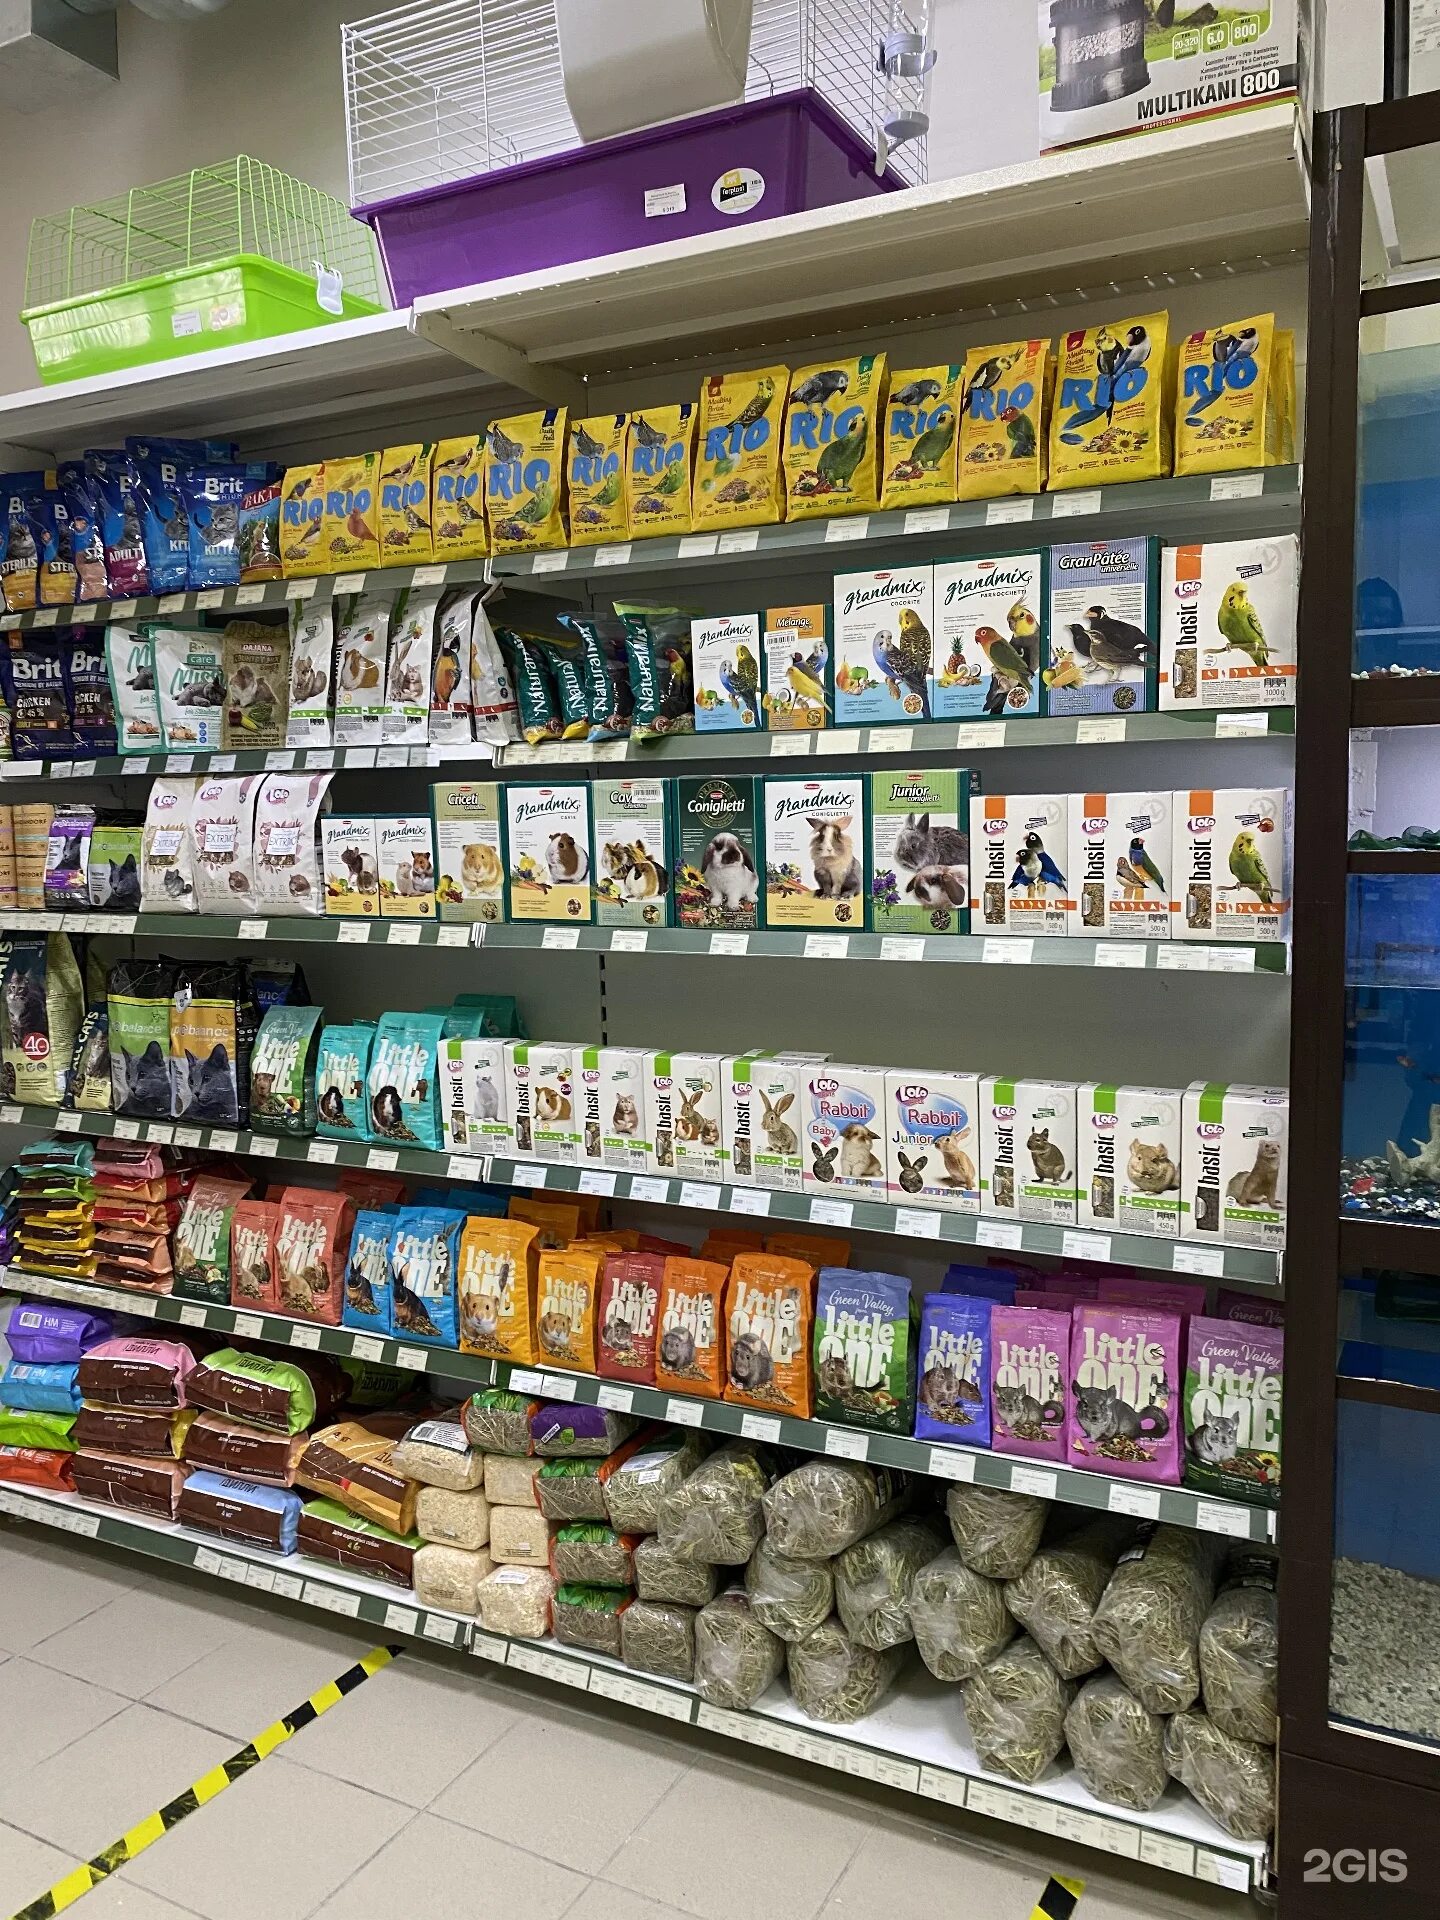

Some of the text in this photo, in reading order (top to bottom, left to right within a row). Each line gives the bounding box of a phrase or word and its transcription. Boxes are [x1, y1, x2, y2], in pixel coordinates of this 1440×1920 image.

[1206, 30, 1224, 45] 6.0
[1234, 23, 1256, 39] 800
[1137, 79, 1237, 120] MULTIKANI
[1243, 69, 1280, 95] 800
[1060, 367, 1149, 412] RIO
[1184, 356, 1258, 398] RIO
[971, 381, 1034, 422] RIO
[790, 405, 865, 450] RIO
[890, 403, 951, 439] RIO
[704, 416, 770, 462] RIO
[572, 451, 619, 487] RIO
[633, 441, 684, 477] RIO
[205, 477, 244, 495] Brit
[438, 472, 478, 502] RIO
[489, 458, 551, 500] RIO
[284, 498, 324, 527] RIO
[326, 488, 371, 519] RIO
[382, 484, 426, 512] RIO
[1059, 552, 1131, 572] GranPâtée
[844, 578, 927, 615] grandmix
[944, 568, 1033, 605] grandmix
[699, 623, 754, 649] grandmix
[1176, 601, 1198, 646] basic
[70, 650, 106, 673] Bri
[190, 656, 213, 664] care
[242, 644, 272, 652] DAJANA
[11, 658, 62, 679] Brit
[447, 792, 478, 806] Criceti
[610, 790, 633, 804] Cav
[698, 780, 737, 800] PREMIUM
[890, 784, 930, 802] Junior
[516, 794, 581, 824] grandmix
[687, 799, 746, 816] Coniglietti
[774, 789, 855, 822] grandmix
[327, 825, 370, 844] grandmix
[381, 825, 427, 846] grandmix
[984, 840, 1006, 880] basic
[1084, 839, 1105, 880] basic
[1188, 838, 1212, 881] basic
[78, 1011, 99, 1043] CATS
[24, 1035, 50, 1056] 40
[376, 1038, 429, 1066] Little
[324, 1051, 359, 1070] Little
[452, 1076, 464, 1108] basic
[516, 1081, 530, 1114] basic
[585, 1087, 600, 1120] basic
[656, 1094, 671, 1128] basic
[734, 1100, 750, 1136] basic
[820, 1100, 870, 1120] Rabbit
[908, 1108, 964, 1127] Rabbit
[812, 1124, 836, 1138] Baby
[892, 1130, 934, 1146] Junior
[994, 1124, 1014, 1164] basic
[1094, 1134, 1115, 1174] basic
[1198, 1144, 1221, 1186] basic
[184, 1200, 224, 1228] Little
[284, 1214, 327, 1241] Little
[236, 1224, 268, 1246] Little
[393, 1232, 448, 1260] Little
[466, 1245, 516, 1274] Little
[545, 1276, 588, 1303] Little
[610, 1278, 658, 1304] Little
[666, 1288, 713, 1317] Little
[734, 1282, 798, 1321] Little
[829, 1290, 895, 1316] Green Valley
[824, 1304, 896, 1346] Little
[929, 1326, 984, 1354] Little
[999, 1340, 1060, 1368] Little
[1083, 1327, 1166, 1366] Little
[1201, 1339, 1282, 1368] Green Valley
[1197, 1356, 1282, 1401] Little
